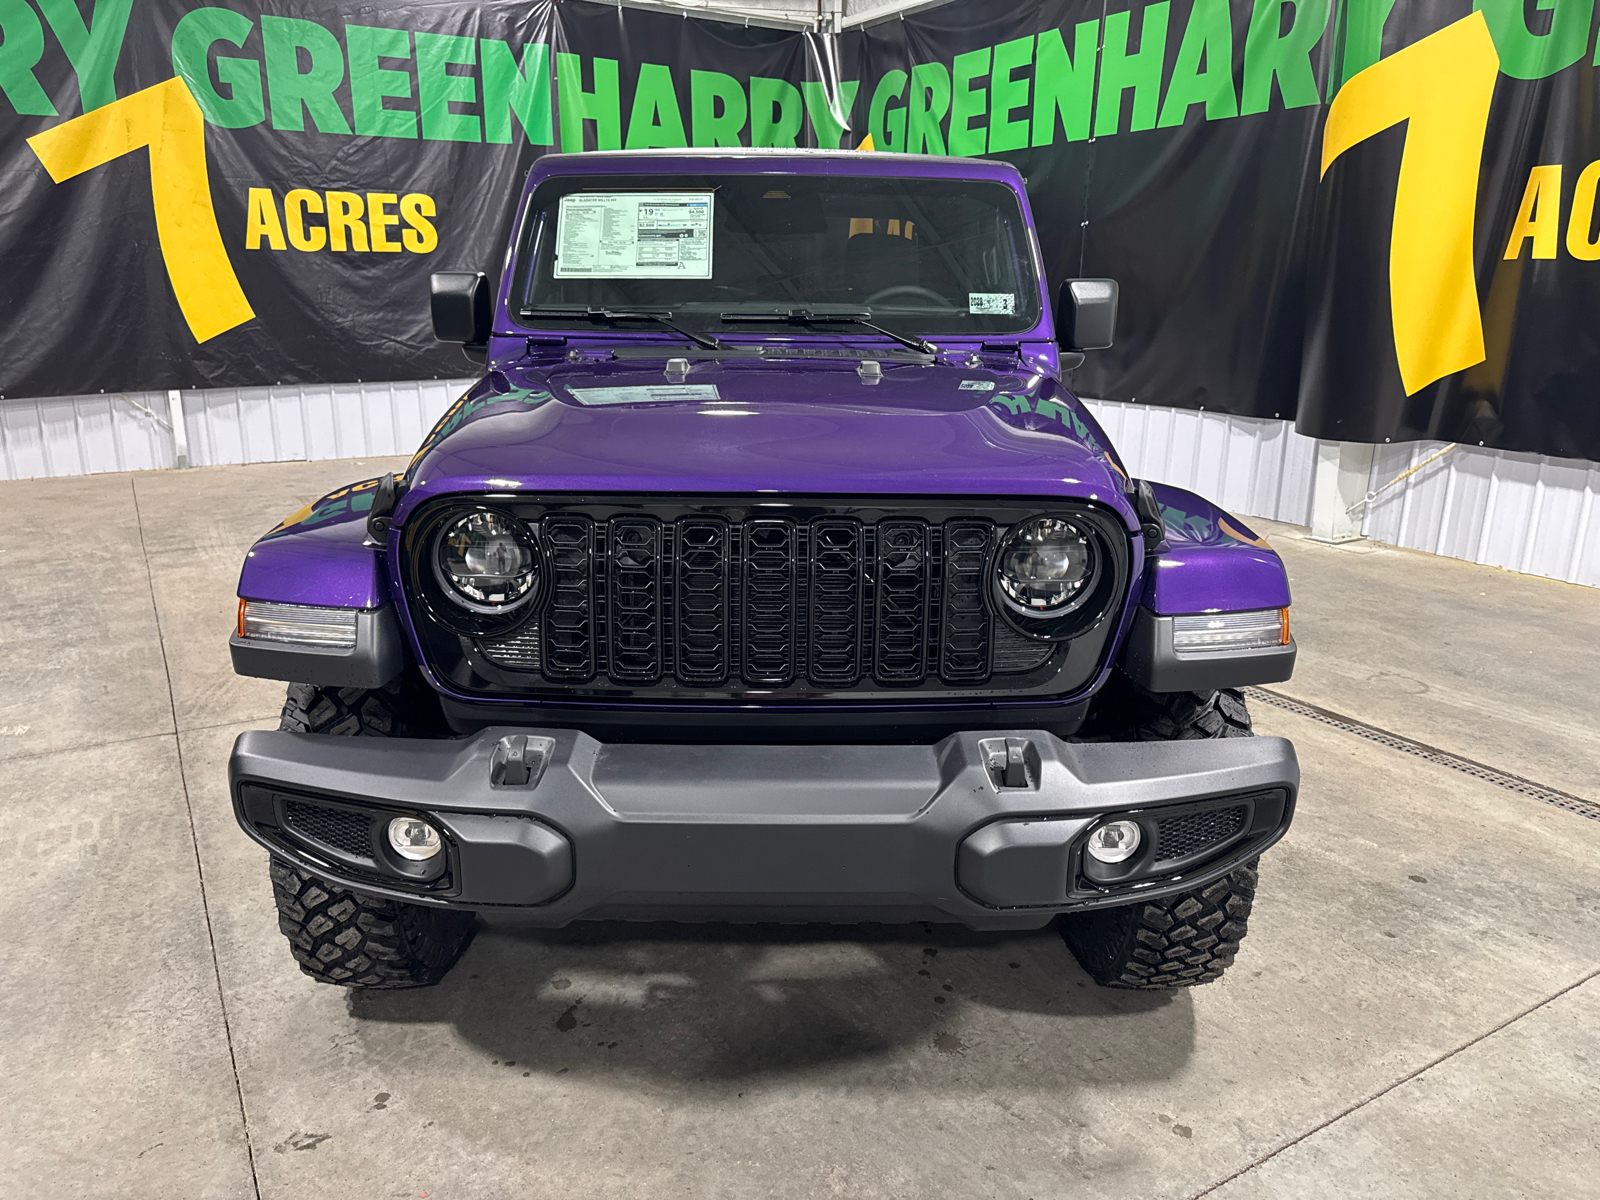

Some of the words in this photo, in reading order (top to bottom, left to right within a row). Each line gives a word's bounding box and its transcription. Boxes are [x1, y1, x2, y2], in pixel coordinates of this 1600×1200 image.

[172, 7, 554, 146] GREEN
[556, 52, 859, 153] HARRY
[868, 18, 1100, 157] GREEN
[1094, 0, 1397, 138] HARRY
[26, 75, 256, 344] 7
[245, 187, 438, 254] ACRES
[644, 208, 654, 216] 19
[677, 261, 686, 269] A
[1320, 9, 1500, 397] 7
